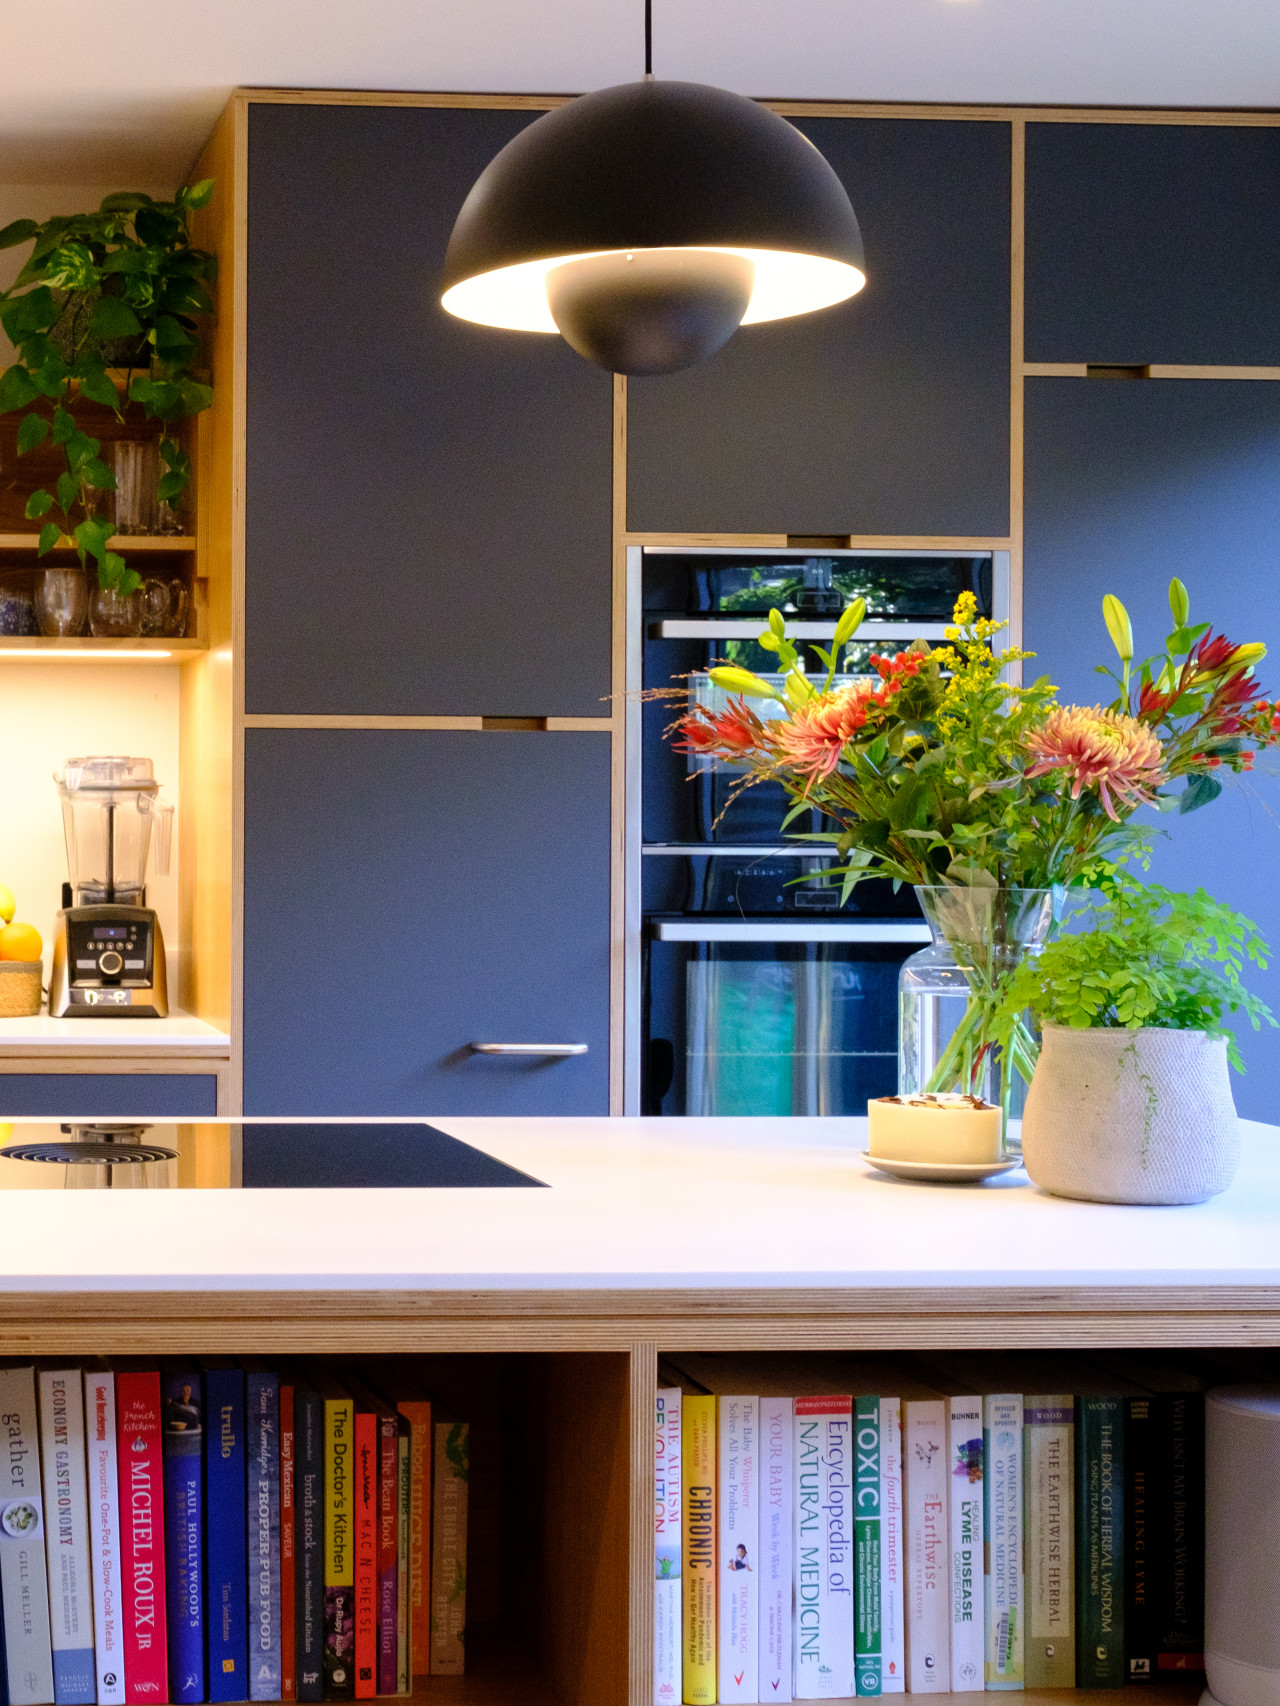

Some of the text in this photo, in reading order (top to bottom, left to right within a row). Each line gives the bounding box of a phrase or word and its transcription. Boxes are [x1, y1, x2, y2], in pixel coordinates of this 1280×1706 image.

[2, 1413, 26, 1487] gather
[52, 1380, 73, 1546] ECONOMY GASTRONOMY
[221, 1405, 235, 1458] trullo
[281, 1432, 293, 1507] Easy Mexican
[668, 1405, 680, 1523] THE AUTISM
[728, 1402, 739, 1530] Solves All Your Problems
[740, 1403, 753, 1508] The Baby Whisperer
[857, 1408, 878, 1507] TOXIC
[887, 1455, 897, 1472] the
[304, 1474, 316, 1507] broth
[304, 1518, 316, 1549] stock
[333, 1408, 349, 1573] The Doctor's Kitchen
[360, 1520, 372, 1552] MAC
[382, 1452, 394, 1549] The Bean Book
[688, 1486, 713, 1569] CHRONIC
[769, 1413, 783, 1580] YOUR BABY Week by Week
[820, 1421, 849, 1564] Encyclopedia
[883, 1474, 901, 1514] fourth
[995, 1460, 1006, 1607] OF NATURAL MEDICINE
[1048, 1439, 1061, 1626] THE EARTHWISE HERBAL
[1090, 1460, 1099, 1596] USING PLANTS AS MEDICINES
[1101, 1423, 1113, 1632] THE BOOK OF HERBAL WISDOM
[1134, 1472, 1145, 1605] HEALING LYME
[99, 1450, 115, 1651] Favourite One-Pot & Slow-Cook Meals
[131, 1461, 155, 1649] MICHEL ROUX JR
[186, 1481, 200, 1627] PAUL HOLLYWOOD'S
[258, 1479, 272, 1650] PROPER PUB FOOD
[284, 1523, 292, 1558] SAVEUR
[359, 1558, 373, 1566] N
[798, 1422, 821, 1664] NATURAL MEDICINE
[830, 1572, 851, 1596] of
[887, 1517, 899, 1583] trimester
[924, 1501, 942, 1589] Earthwise
[953, 1552, 961, 1623] COINFECTIONS
[961, 1501, 972, 1622] LYME DISEASE
[19, 1551, 33, 1635] GILL MELLER
[359, 1576, 372, 1635] CHEESE
[382, 1581, 394, 1654] Rose Elliot
[739, 1584, 749, 1654] TRACY HOGG
